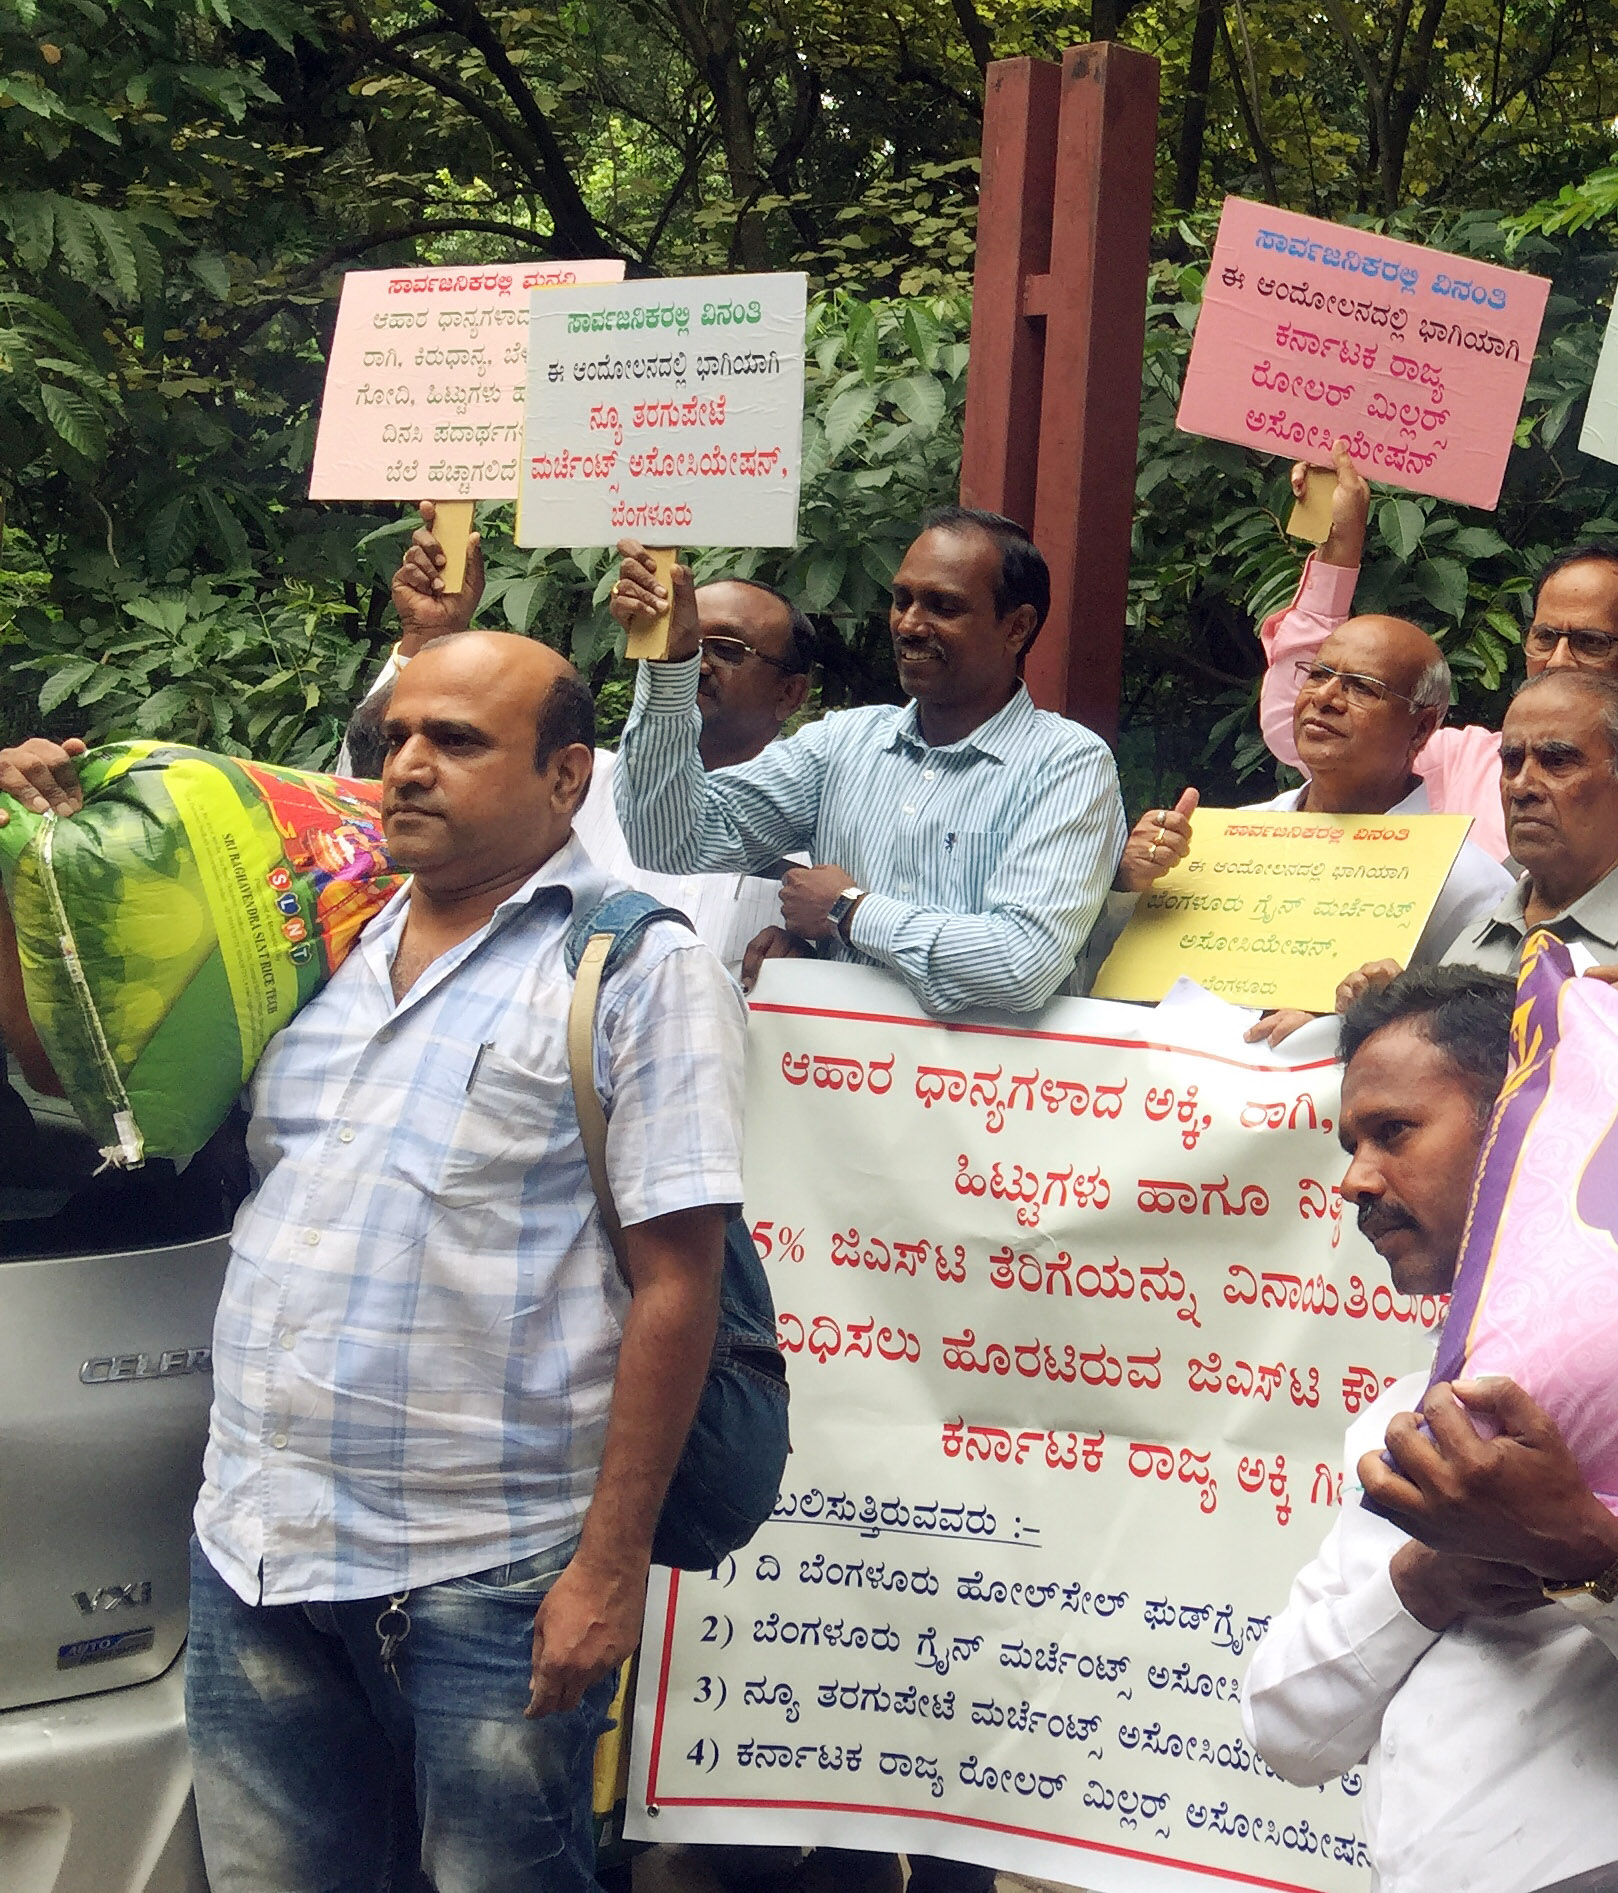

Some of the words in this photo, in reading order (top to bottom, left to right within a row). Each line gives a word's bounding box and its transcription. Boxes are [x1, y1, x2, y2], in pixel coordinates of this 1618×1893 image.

[388, 271, 513, 297] ಸಾರ್ವಜನಿಕರಲ್ಲಿ
[1255, 228, 1419, 296] ಸಾರ್ವಜನಿಕರಲ್ಲಿ
[1431, 271, 1508, 311] ವಿನಂತಿ
[373, 308, 429, 330] ಆಹಾರ
[567, 301, 690, 336] ಸಾರ್ವಜನಿಕರಲ್ಲಿ
[701, 298, 762, 326] ವಿನಂತಿ
[1221, 266, 1245, 291] ಈ
[1257, 274, 1409, 343] ಆಂದೋಲನದಲ್ಲಿ
[1418, 317, 1520, 362] ಭಾಗಿಯಾಗಿ
[362, 347, 403, 369] ರಾಗಿ,
[547, 358, 564, 383] ಈ
[573, 351, 688, 389] ಆಂದೋಲನದಲ್ಲಿ
[696, 350, 780, 382] ಭಾಗಿಯಾಗಿ
[1275, 320, 1378, 370] ಕರ್ನಾಟಕ
[1390, 353, 1446, 405] ರಾಜ್ಯ
[426, 383, 501, 415] ಹಿಟ್ಟುಗಳು
[1251, 360, 1355, 407] ರೋಲರ್
[382, 422, 423, 444] ದಿನಸಿ
[589, 401, 624, 446] ನ್ಯೂ
[632, 395, 727, 429] ತರಗುಪೇಟೆ
[386, 459, 419, 483] ಬೆಲೆ
[428, 458, 518, 495] ಹೆಚ್ಚಾಗಲಿದೆ
[611, 500, 693, 527] ಬೆಂಗಳೂರು
[1224, 823, 1344, 845] ಸಾರ್ವಜನಿಕರಲ್ಲಿ
[1353, 825, 1411, 842] ವಿನಂತಿ
[1188, 859, 1206, 875] ಈ
[1213, 858, 1326, 882] ಆಂದೋಲನದಲ್ಲಿ
[1331, 862, 1410, 881] ಭಾಗಿಯಾಗಿ
[222, 833, 235, 852] SRI
[260, 959, 276, 988] RICE
[1147, 889, 1245, 913] ಬೆಂಗಳೂರು
[781, 1051, 895, 1095] ಆಹಾರ
[915, 1063, 1128, 1134] ಧಾನ್ಯಗಳಾದ
[1145, 1084, 1212, 1150] ಅಕ್ಕಿ,
[1240, 1092, 1333, 1135] ರಾಗಿ,
[955, 1153, 1111, 1228] ಹಿಟ್ಟುಗಳು
[1137, 1174, 1270, 1217] ಹಾಗೂ
[989, 1245, 1202, 1328] ತೆರಿಗೆಯನ್ನು
[80, 1349, 213, 1385] CELER
[775, 1312, 921, 1365] ವಿಧಿಸಲು
[942, 1328, 1161, 1390] ಹೊರಟಿರುವ
[941, 1414, 1106, 1473] ಕರ್ನಾಟಕ
[1128, 1442, 1217, 1515] ರಾಜ್ಯ
[1237, 1454, 1292, 1527] ಅಕ್ಕಿ
[772, 1488, 998, 1538] ಬಲಿಸುತ್ತಿರುವವರು
[755, 1554, 781, 1582] ದಿ
[799, 1553, 940, 1597] ಬೆಂಗಳೂರು
[700, 1614, 735, 1651] 2)
[752, 1612, 901, 1652] ಬೆಂಗಳೂರು
[914, 1626, 985, 1676] ಗ್ರೈನ್
[999, 1638, 1132, 1701] ಮರ್ಚೆಂಟ್ಸ್
[1147, 1662, 1242, 1704] ಅಸೋಸಿ
[693, 1675, 728, 1712] 3)
[743, 1675, 801, 1724] ನ್ಯೂ
[816, 1679, 957, 1721] ತರಗುಪೇಟೆ
[970, 1698, 1104, 1761] ಮರ್ಚೆಂಟ್ಸ್
[686, 1737, 720, 1774] 4)
[736, 1737, 863, 1773] ಕರ್ನಾಟಕ
[879, 1751, 945, 1798] ರಾಜ್ಯ
[958, 1755, 1068, 1800] ರೋಲರ್
[1083, 1779, 1172, 1840] ಮಿಲ್ಲರ್ಸ್
